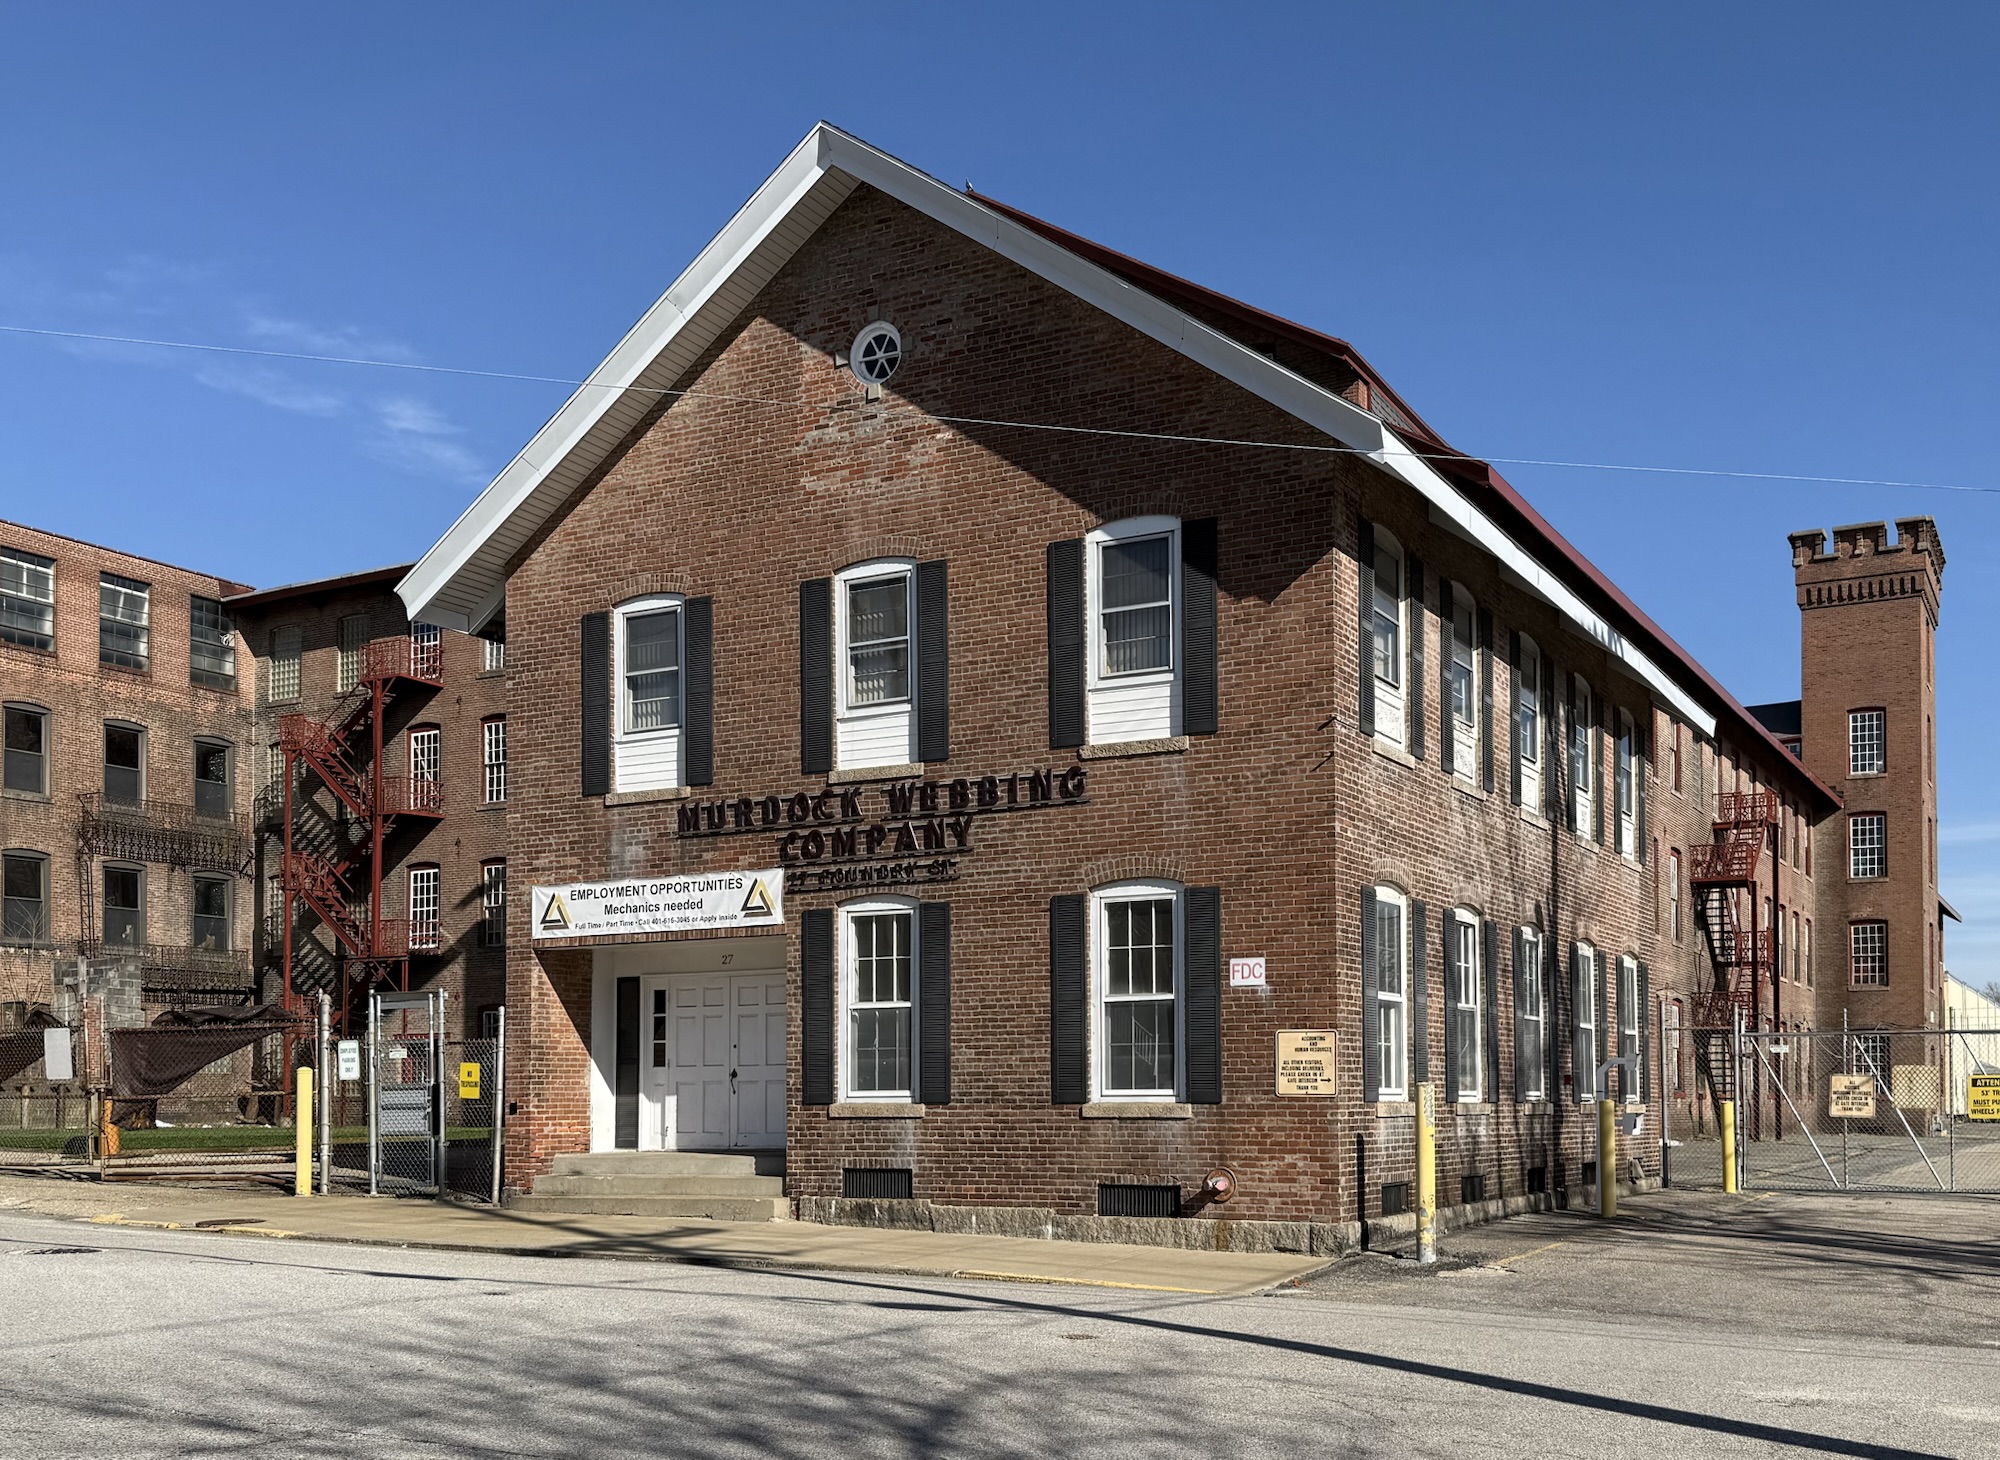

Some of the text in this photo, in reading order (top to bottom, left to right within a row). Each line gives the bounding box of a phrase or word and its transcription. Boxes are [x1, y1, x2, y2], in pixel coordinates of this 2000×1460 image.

[677, 765, 1085, 833] MURDOCK WEBBING
[779, 815, 973, 861] COMPANY
[817, 861, 917, 885] FOUNDRY
[570, 877, 743, 901] EMPLOYMENT OPPORTUNITIES
[604, 897, 703, 916] Mechanics needed
[574, 922, 586, 930] Full
[605, 920, 618, 928] Part
[619, 919, 634, 927] Time
[638, 918, 650, 926] Call
[700, 914, 717, 923] Apply
[719, 913, 738, 921] Inside
[721, 954, 734, 965] 27
[1232, 962, 1263, 980] FDC
[467, 1070, 473, 1078] NO
[1976, 1079, 2000, 1087] ATTEN
